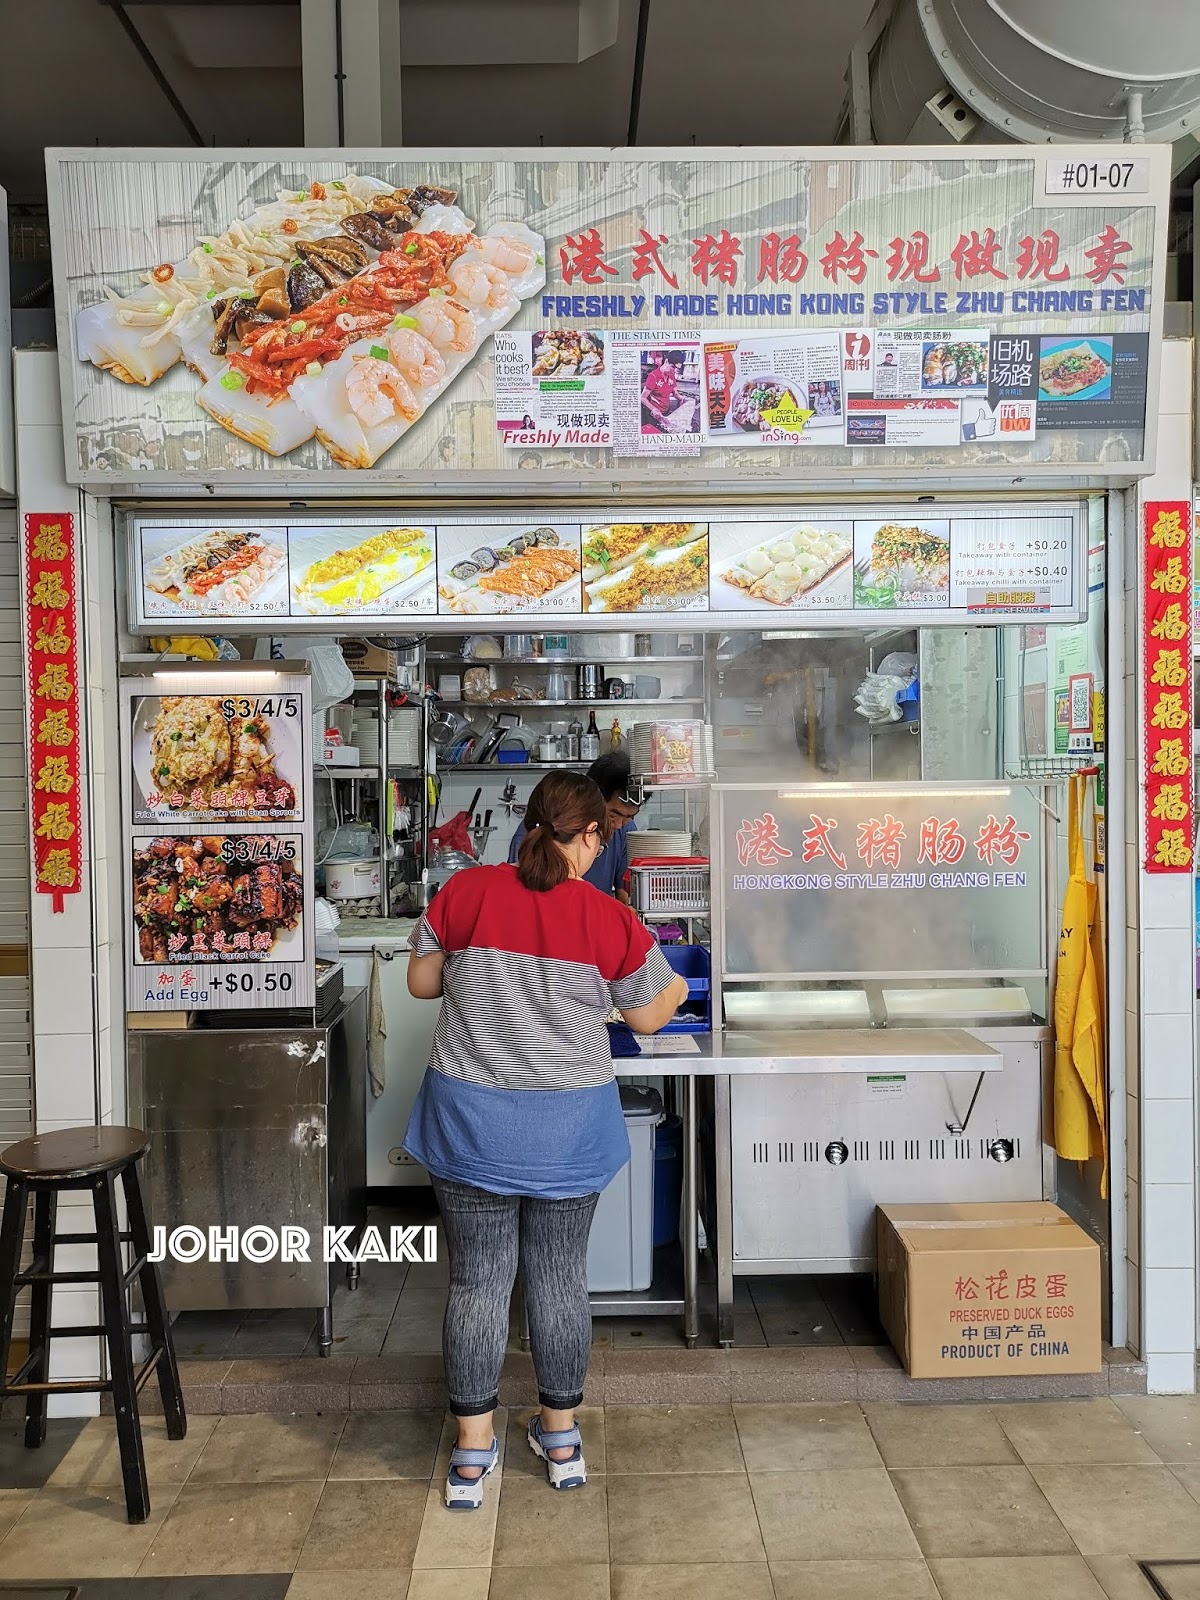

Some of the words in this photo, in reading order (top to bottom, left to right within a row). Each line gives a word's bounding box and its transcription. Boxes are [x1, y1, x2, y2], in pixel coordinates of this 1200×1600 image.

[1062, 163, 1135, 188] #01-07
[559, 225, 1133, 290] 港式猪肠粉现做现卖
[541, 294, 645, 318] FRESHLY
[654, 294, 719, 317] MADE
[727, 293, 792, 316] HONG
[800, 292, 865, 315] KONG
[873, 292, 948, 315] STYLE
[956, 291, 1001, 314] ZHU
[1012, 290, 1093, 313] CHANG
[1100, 289, 1145, 312] FEN
[611, 331, 631, 340] THE
[633, 331, 670, 340] STRAITS
[671, 330, 701, 340] TIMES
[893, 331, 952, 341] 现做现卖肠粉
[496, 340, 517, 351] Who
[992, 338, 1033, 362] 旧机
[495, 352, 524, 363] cooks
[496, 363, 503, 375] it
[504, 363, 530, 375] best?
[844, 359, 870, 371] 周刊
[990, 363, 1033, 387] 场路
[707, 353, 727, 430] 美味天堂
[556, 412, 610, 428] 现做现卖
[771, 415, 791, 423] LOVE
[503, 429, 561, 448] Freshly
[564, 429, 610, 443] Made
[641, 434, 708, 444] HAND-MADE
[1026, 540, 1067, 550] +$0.20
[1026, 566, 1068, 576] +$0.40
[394, 600, 419, 608] $2.50
[540, 598, 563, 606] $3.00
[667, 597, 691, 605] $3.00
[811, 596, 835, 604] $3.50
[923, 594, 947, 603] $3.00
[249, 603, 273, 611] $2.50
[222, 698, 298, 720] $3/4/5
[157, 810, 180, 818] White
[182, 809, 208, 818] Carrot
[208, 809, 228, 817] Cake
[229, 809, 247, 817] with
[248, 808, 268, 817] Bean
[269, 808, 301, 818] Sprouts
[735, 812, 1032, 870] 港式猪肠粉
[221, 839, 297, 863] $3/4/5
[733, 874, 831, 890] HONGKONG
[834, 873, 888, 889] STYLE
[890, 872, 926, 888] ZHU
[928, 872, 989, 888] CHANG
[993, 871, 1027, 887] FEN
[168, 952, 192, 961] Fried
[194, 951, 219, 960] Black
[219, 951, 249, 960] Carrot
[249, 951, 271, 960] Cake
[157, 968, 197, 987] 加蛋
[208, 972, 293, 994] +$0.50
[144, 989, 174, 1001] Add
[180, 988, 209, 1002] Egg
[955, 1269, 1068, 1301] 松花皮蛋
[949, 1308, 1009, 1323] PRESERVED
[1014, 1306, 1043, 1321] DUCK
[1046, 1305, 1074, 1319] EGGS
[961, 1324, 1047, 1341] 中国产品
[941, 1344, 1001, 1359] PRODUCT
[1007, 1343, 1023, 1357] OF
[1030, 1341, 1070, 1356] CHINA
